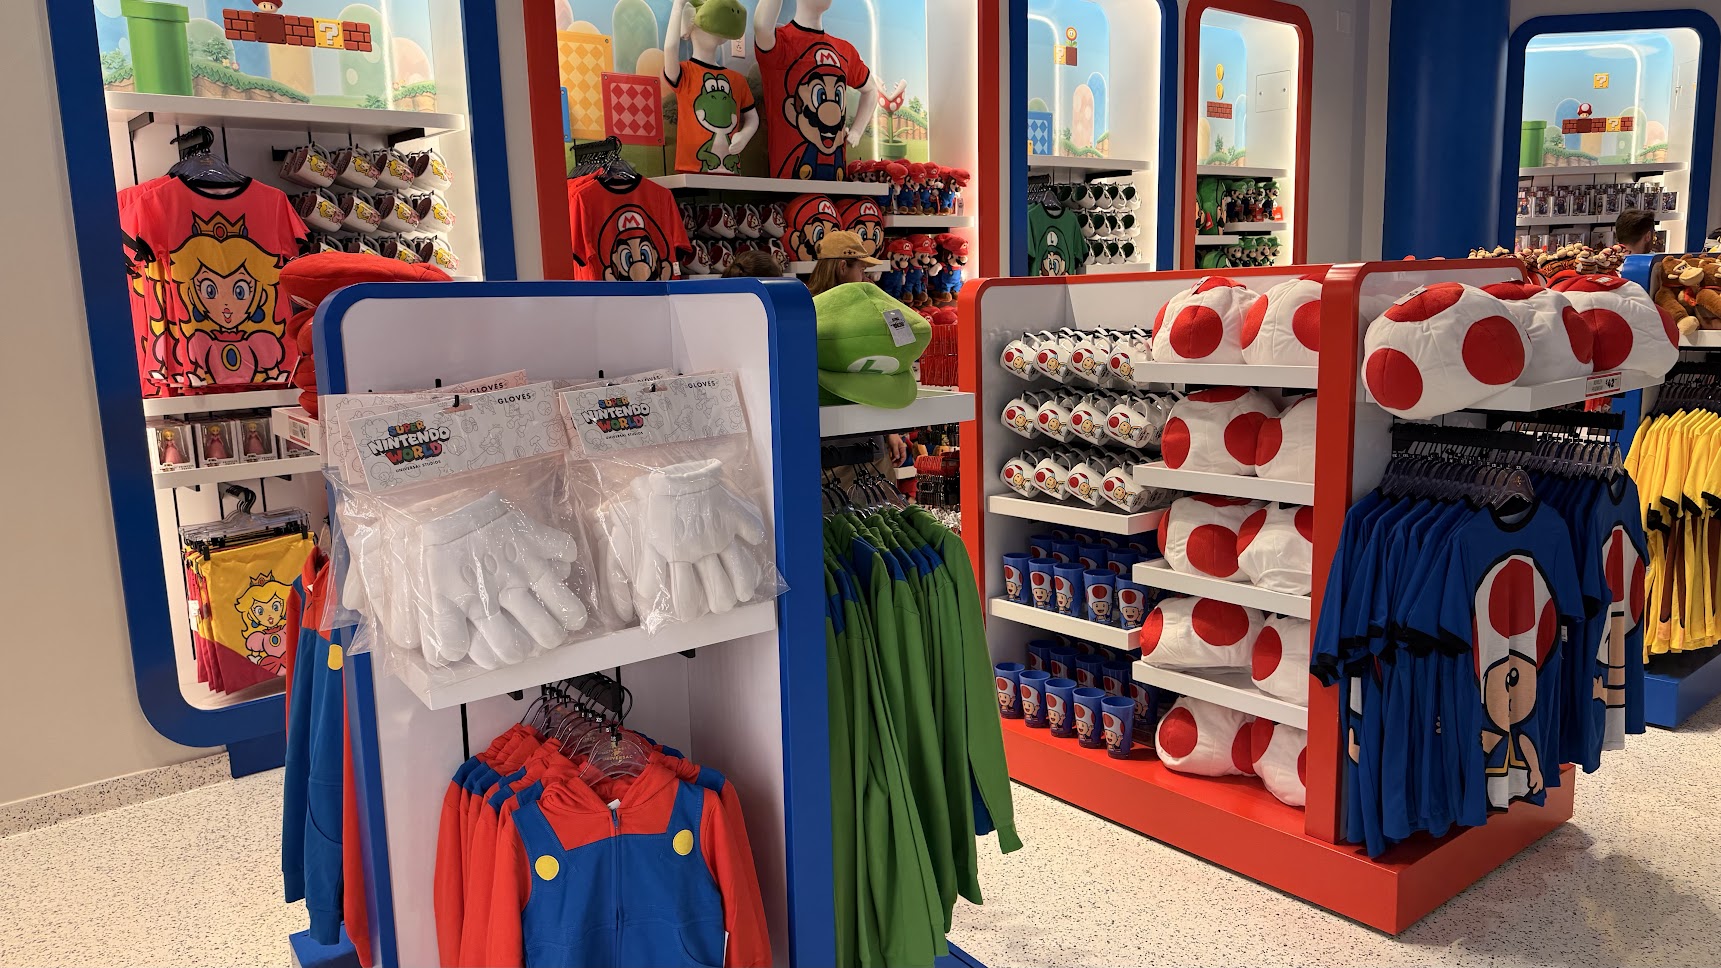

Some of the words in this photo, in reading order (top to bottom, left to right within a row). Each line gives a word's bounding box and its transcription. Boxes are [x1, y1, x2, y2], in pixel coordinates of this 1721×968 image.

[319, 22, 339, 46] ?
[819, 51, 838, 65] M
[1596, 75, 1607, 88] ?
[1608, 118, 1619, 131] ?
[821, 202, 835, 215] M
[863, 204, 876, 214] M
[622, 214, 641, 229] M
[858, 359, 884, 374] L
[687, 380, 716, 389] GLOVES
[497, 392, 532, 405] GLOVES
[598, 395, 630, 409] SUPER
[581, 403, 651, 425] NINTENDO
[388, 419, 427, 437] SUPER
[596, 415, 644, 434] WORLD
[367, 426, 452, 457] NINTENDO
[385, 440, 443, 466] WORLD
[395, 465, 422, 473] UNIVERSAL
[422, 460, 442, 468] STUDIOS
